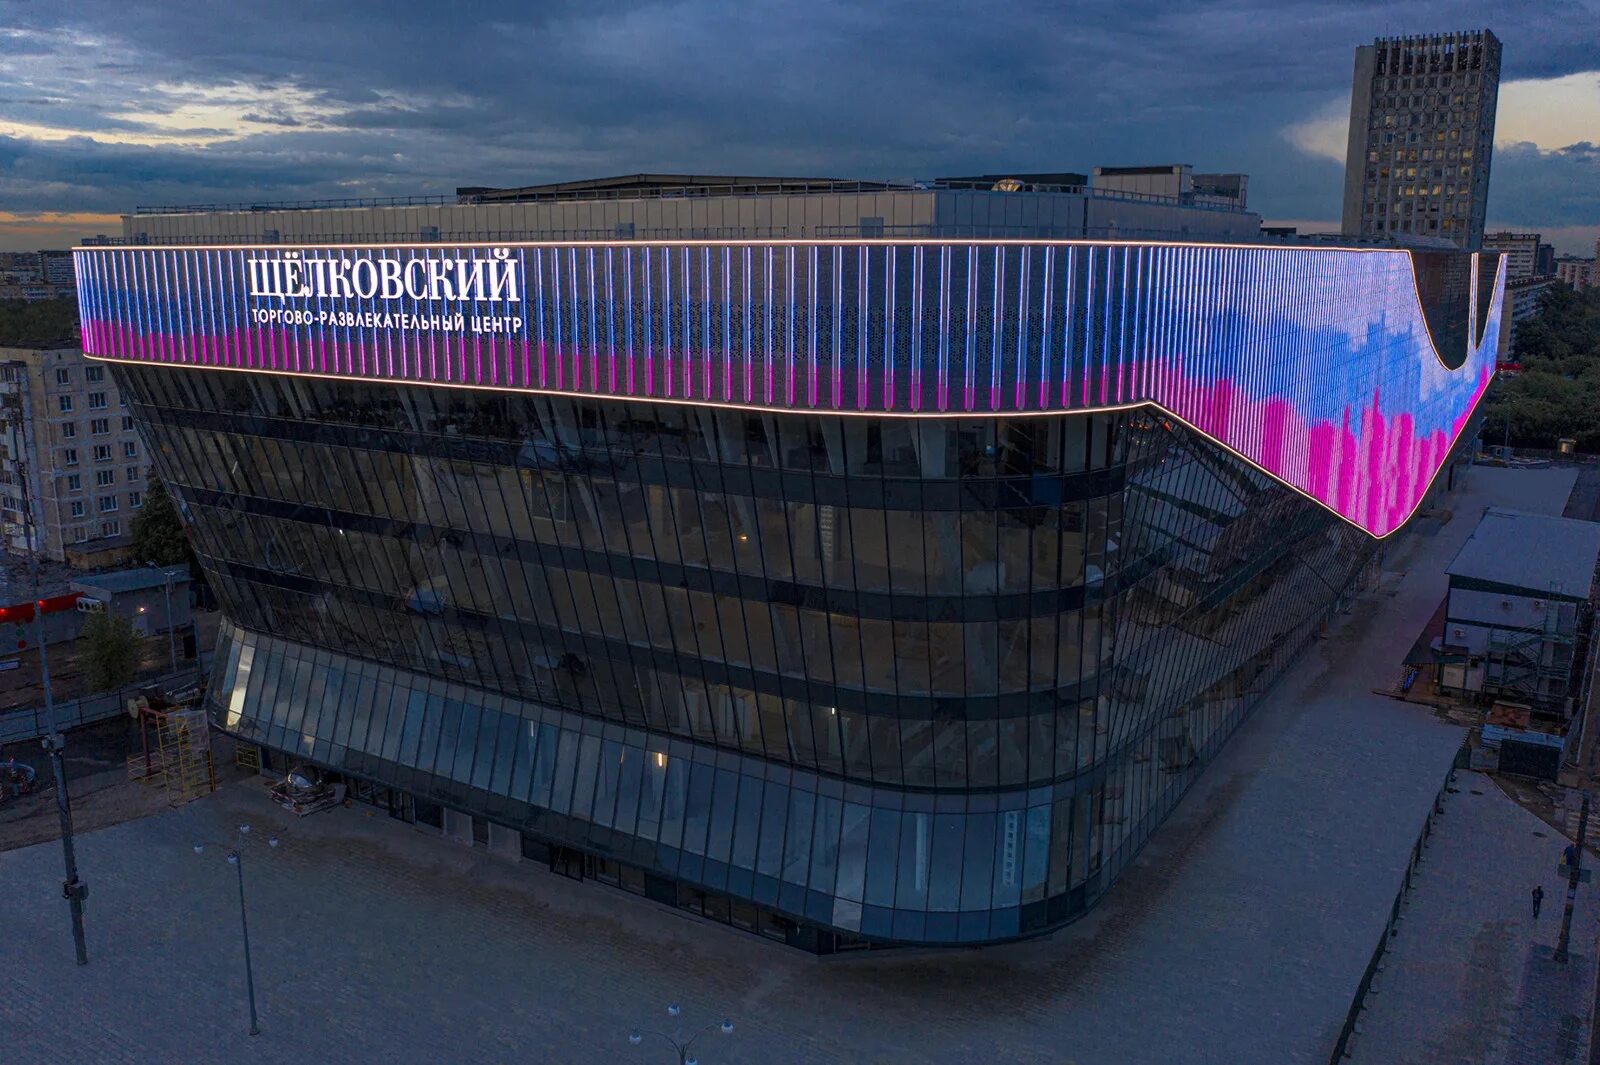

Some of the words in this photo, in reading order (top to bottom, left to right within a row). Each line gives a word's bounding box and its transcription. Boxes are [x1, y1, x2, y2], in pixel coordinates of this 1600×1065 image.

[248, 247, 520, 305] ЩЁЛКОВСКИЙ
[252, 309, 464, 332] ТОРГОВО-РАЗВЛЕКАТЕЛЬНЫЙ
[471, 316, 522, 334] ЦЕНТР
